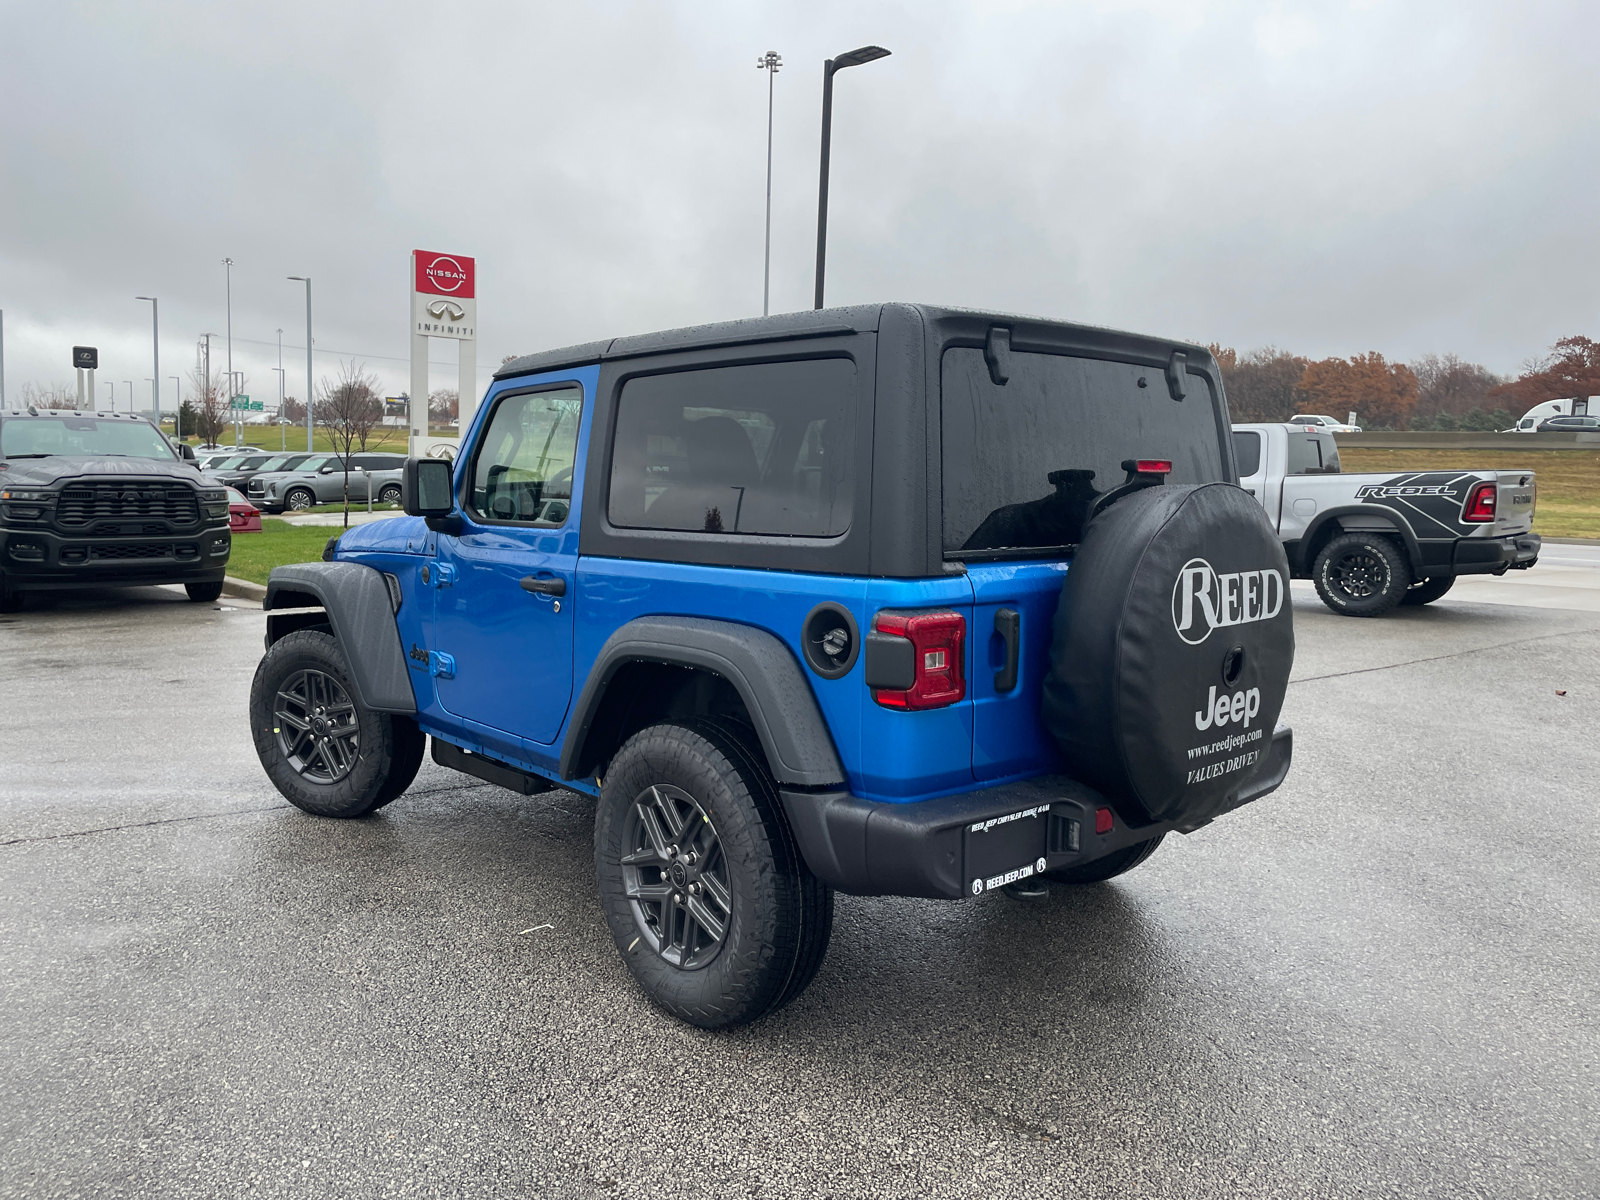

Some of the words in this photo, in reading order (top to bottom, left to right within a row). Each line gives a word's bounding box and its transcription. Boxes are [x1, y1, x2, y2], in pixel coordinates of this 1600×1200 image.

[426, 268, 466, 280] NISSAN
[418, 322, 473, 336] INFINITI
[97, 490, 167, 500] RAM
[1354, 485, 1458, 498] REBEL
[1178, 566, 1284, 631] REED
[1195, 685, 1260, 731] Jeep
[1187, 728, 1263, 760] www.reedjeep.com
[1187, 761, 1225, 785] VALUES
[1037, 803, 1050, 813] RAM
[986, 864, 1034, 891] REEDJEEP.COM
